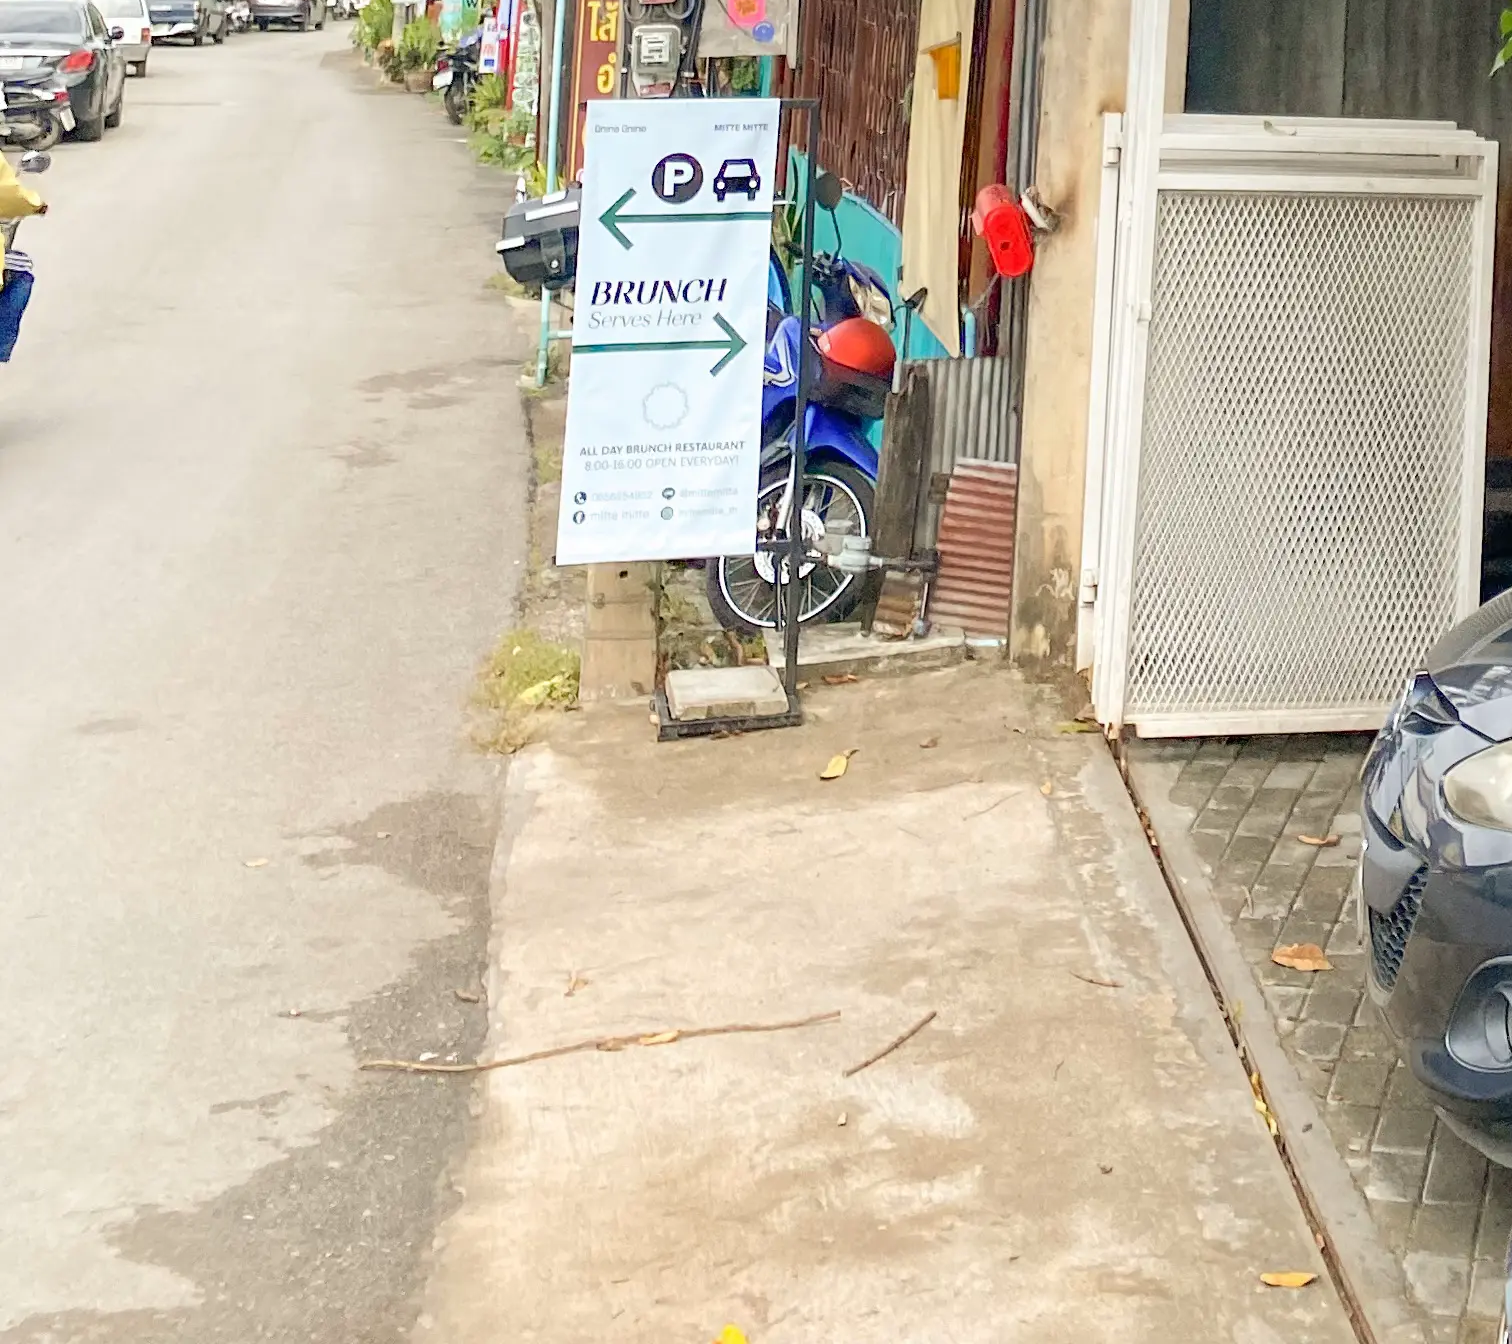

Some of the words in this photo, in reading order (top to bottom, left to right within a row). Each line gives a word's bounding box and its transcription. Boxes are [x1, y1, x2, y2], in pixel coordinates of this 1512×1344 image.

[591, 278, 728, 306] BRUNCH
[588, 310, 651, 330] Serves
[656, 309, 702, 327] Here
[579, 446, 599, 457] ALL
[601, 445, 624, 456] DAY
[626, 443, 672, 455] BRUNCH
[675, 440, 746, 453] RESTAURANT
[645, 456, 677, 468] OPEN
